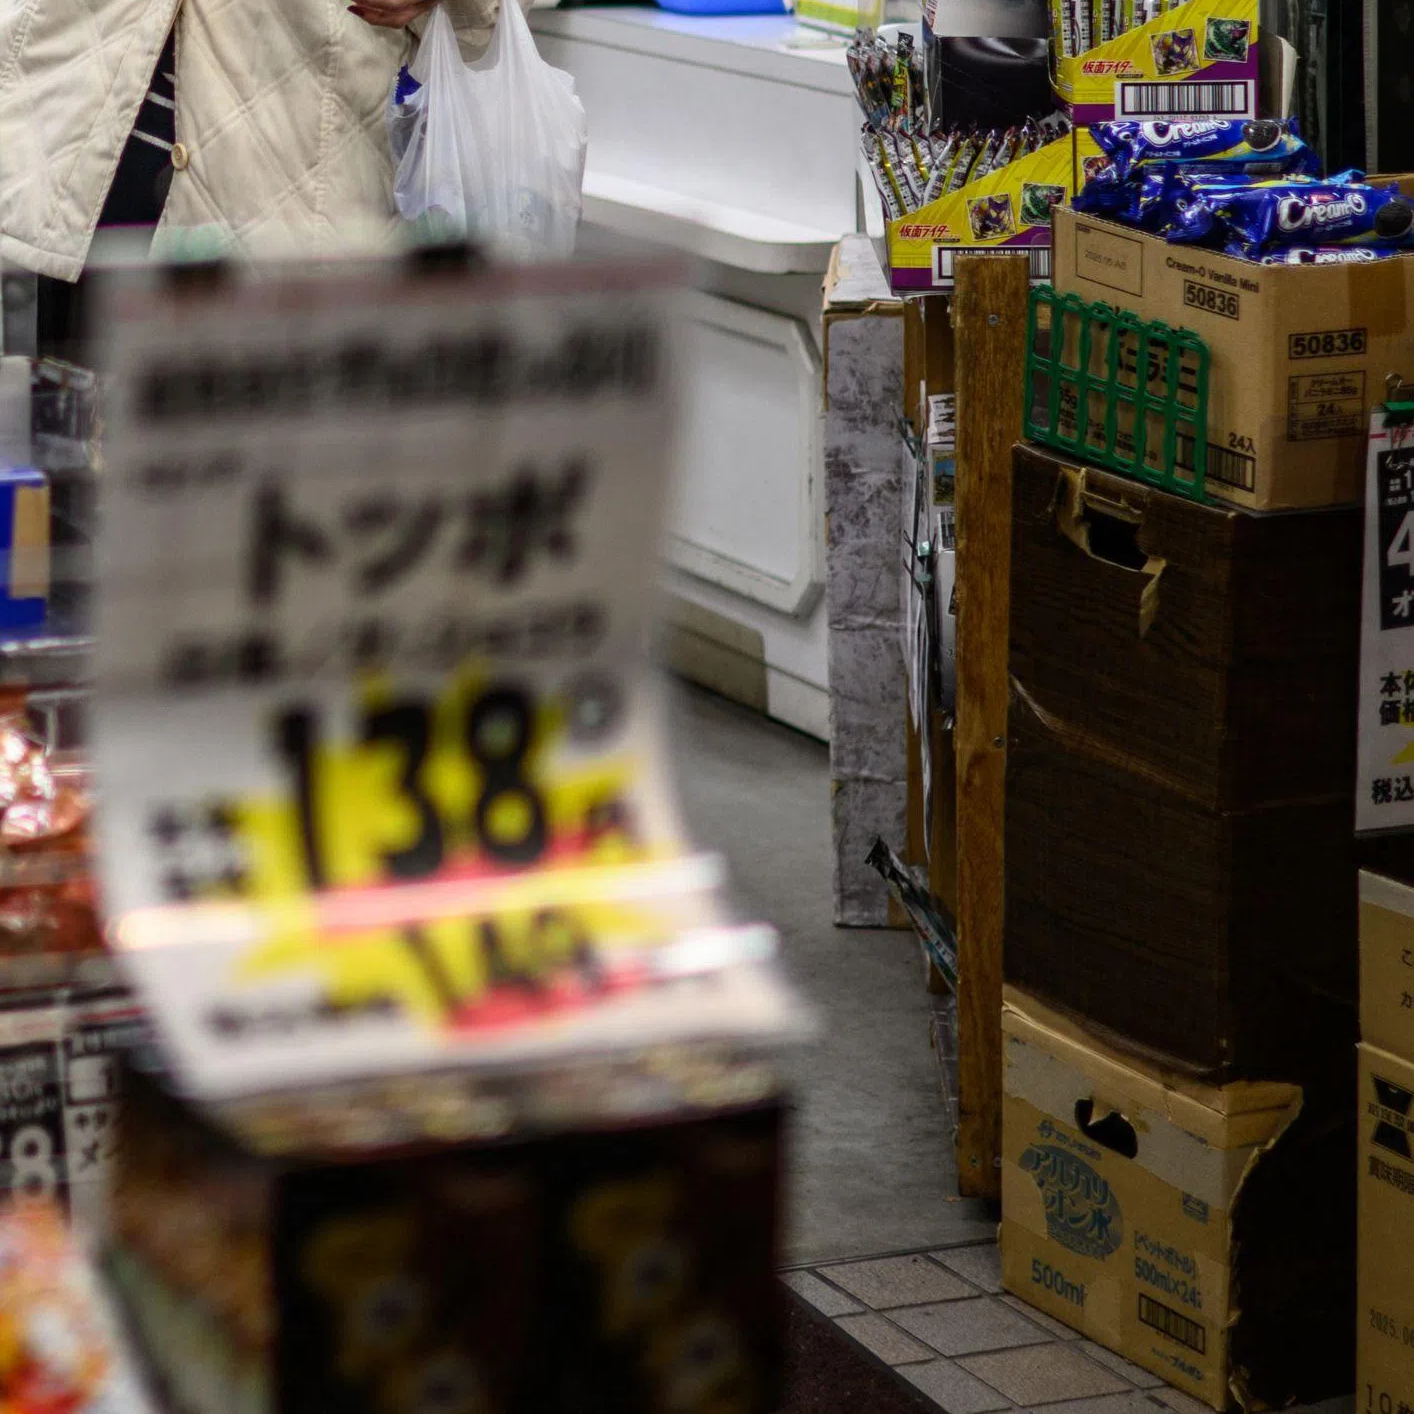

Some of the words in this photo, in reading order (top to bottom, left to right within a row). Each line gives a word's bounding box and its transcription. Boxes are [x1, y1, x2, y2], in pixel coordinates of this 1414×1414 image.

[1081, 60, 1134, 75] 仮面ライダー
[899, 224, 951, 238] 仮面ライダー
[1166, 256, 1206, 277] Cream-O
[1207, 267, 1238, 288] Vanilla
[1239, 277, 1260, 293] Mini
[1186, 283, 1238, 316] 50836
[1293, 332, 1364, 356] 50836
[250, 448, 596, 600] トンボ
[1031, 1257, 1085, 1307] 500ml
